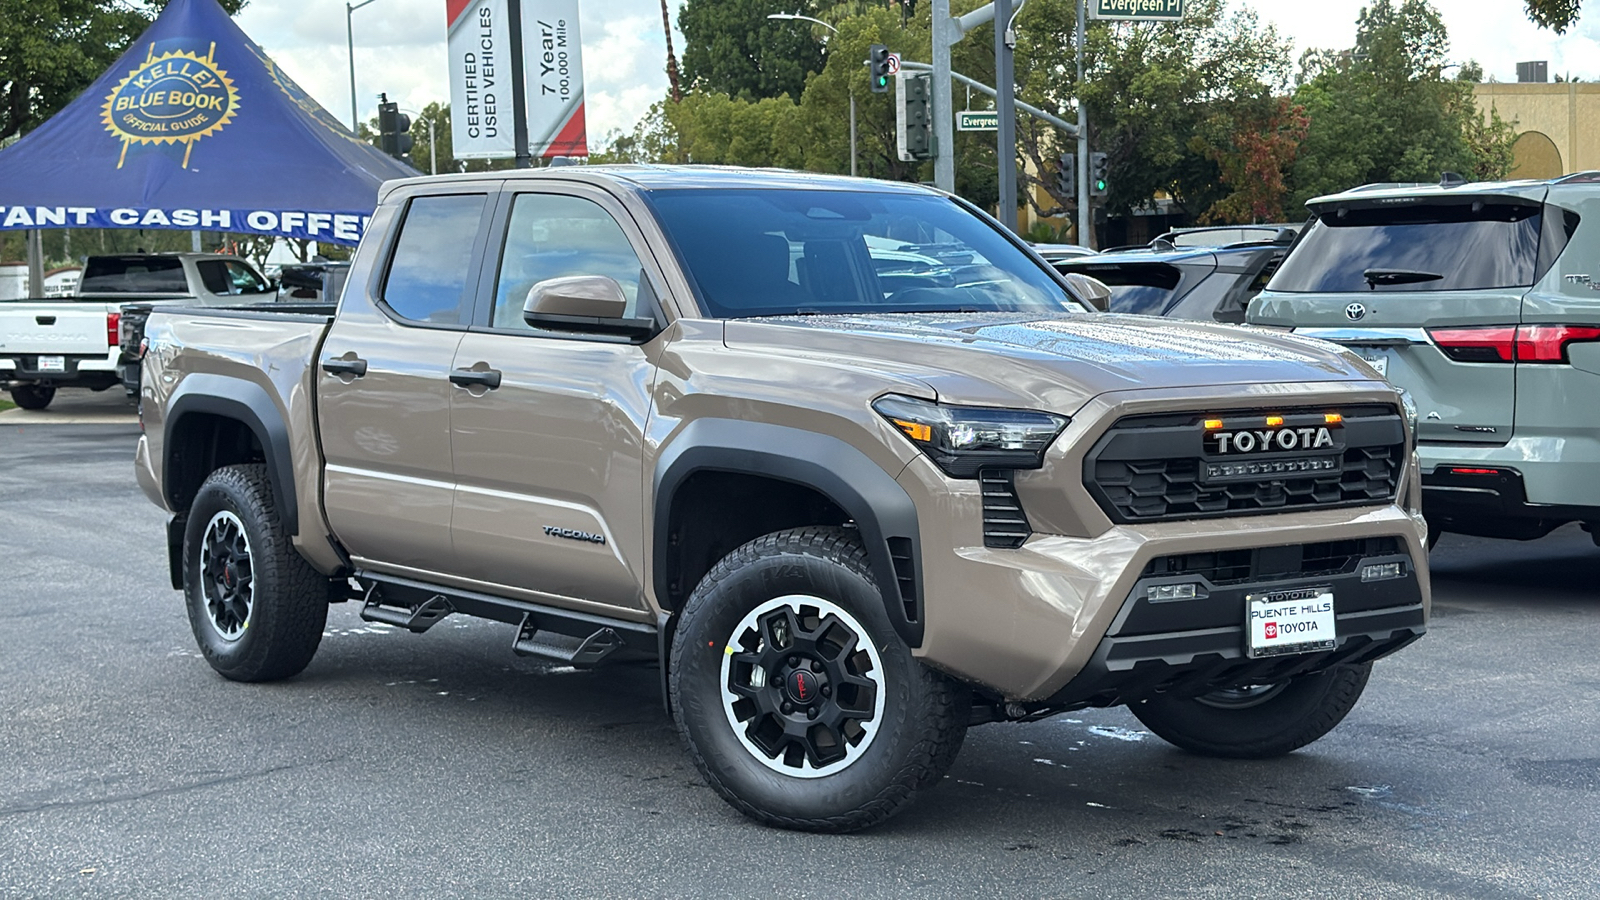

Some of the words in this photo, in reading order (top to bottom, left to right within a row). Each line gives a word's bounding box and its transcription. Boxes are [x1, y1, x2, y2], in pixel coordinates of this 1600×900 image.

[1101, 0, 1164, 15] Evergreen
[1167, 0, 1180, 12] Pl
[556, 19, 567, 48] Mile
[480, 7, 495, 89] VEHICLES
[537, 20, 555, 77] Year/
[133, 62, 221, 89] KELLEY
[557, 51, 570, 102] 100,000
[464, 52, 480, 138] CERTIFIED
[542, 84, 556, 96] 7
[115, 91, 166, 111] BLUE
[168, 91, 224, 111] BOOK
[122, 113, 169, 131] OFFICIAL
[170, 113, 209, 131] GUIDE
[484, 94, 497, 138] USED
[110, 208, 231, 228] CASH
[1213, 427, 1334, 453] TOYOTA
[542, 525, 606, 545] TACOMA
[1269, 590, 1315, 601] TOYOTA
[1251, 606, 1297, 619] PUENTE
[1301, 602, 1332, 614] HILLS
[1278, 621, 1319, 634] TOYOTA
